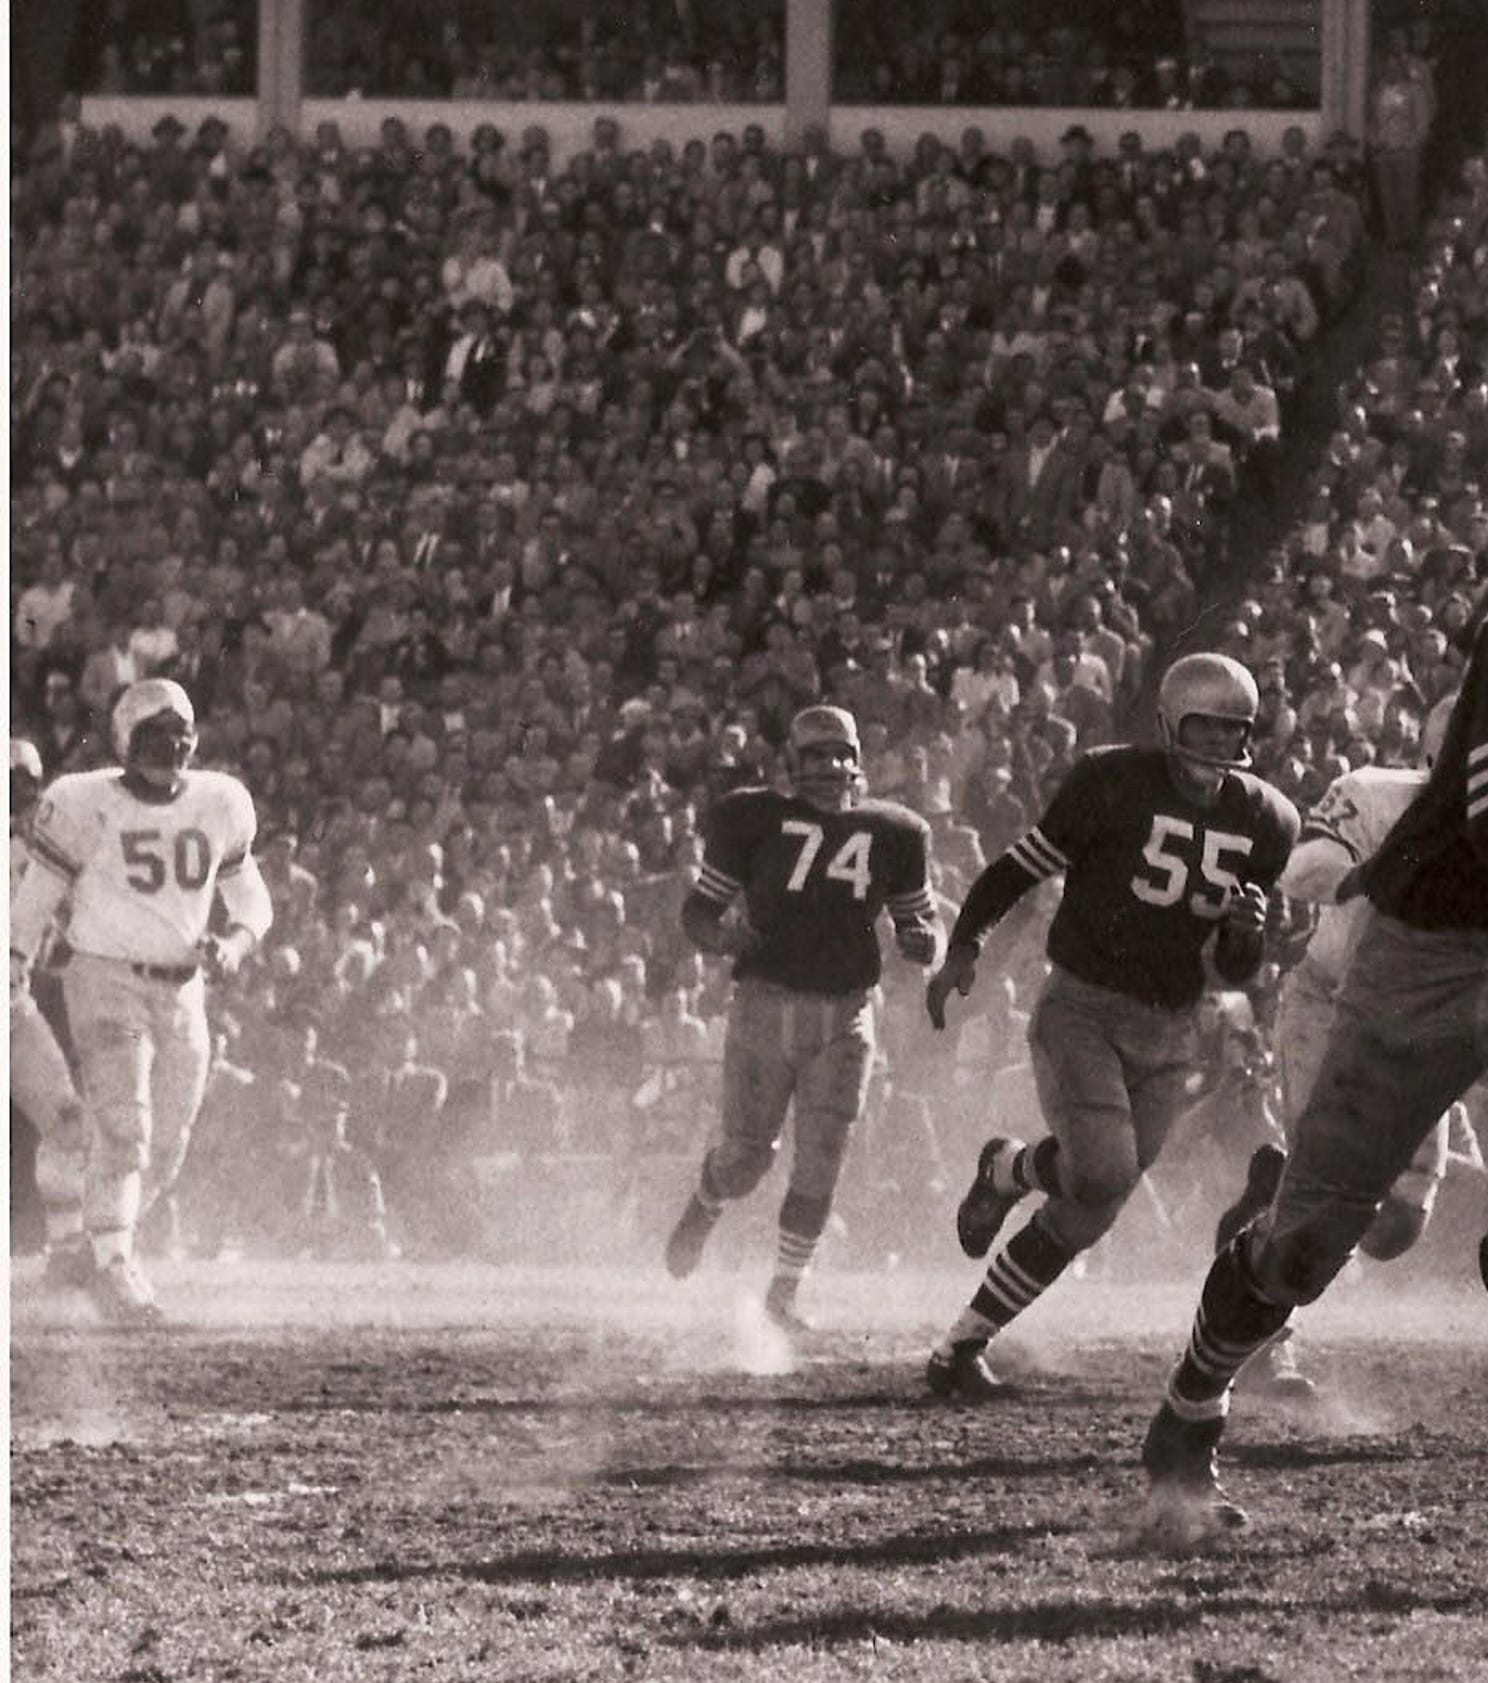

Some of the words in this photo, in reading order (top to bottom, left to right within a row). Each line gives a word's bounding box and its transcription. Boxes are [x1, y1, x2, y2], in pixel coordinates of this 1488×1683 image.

[119, 828, 212, 895] 50
[780, 819, 873, 900] 74
[1129, 813, 1254, 920] 55
